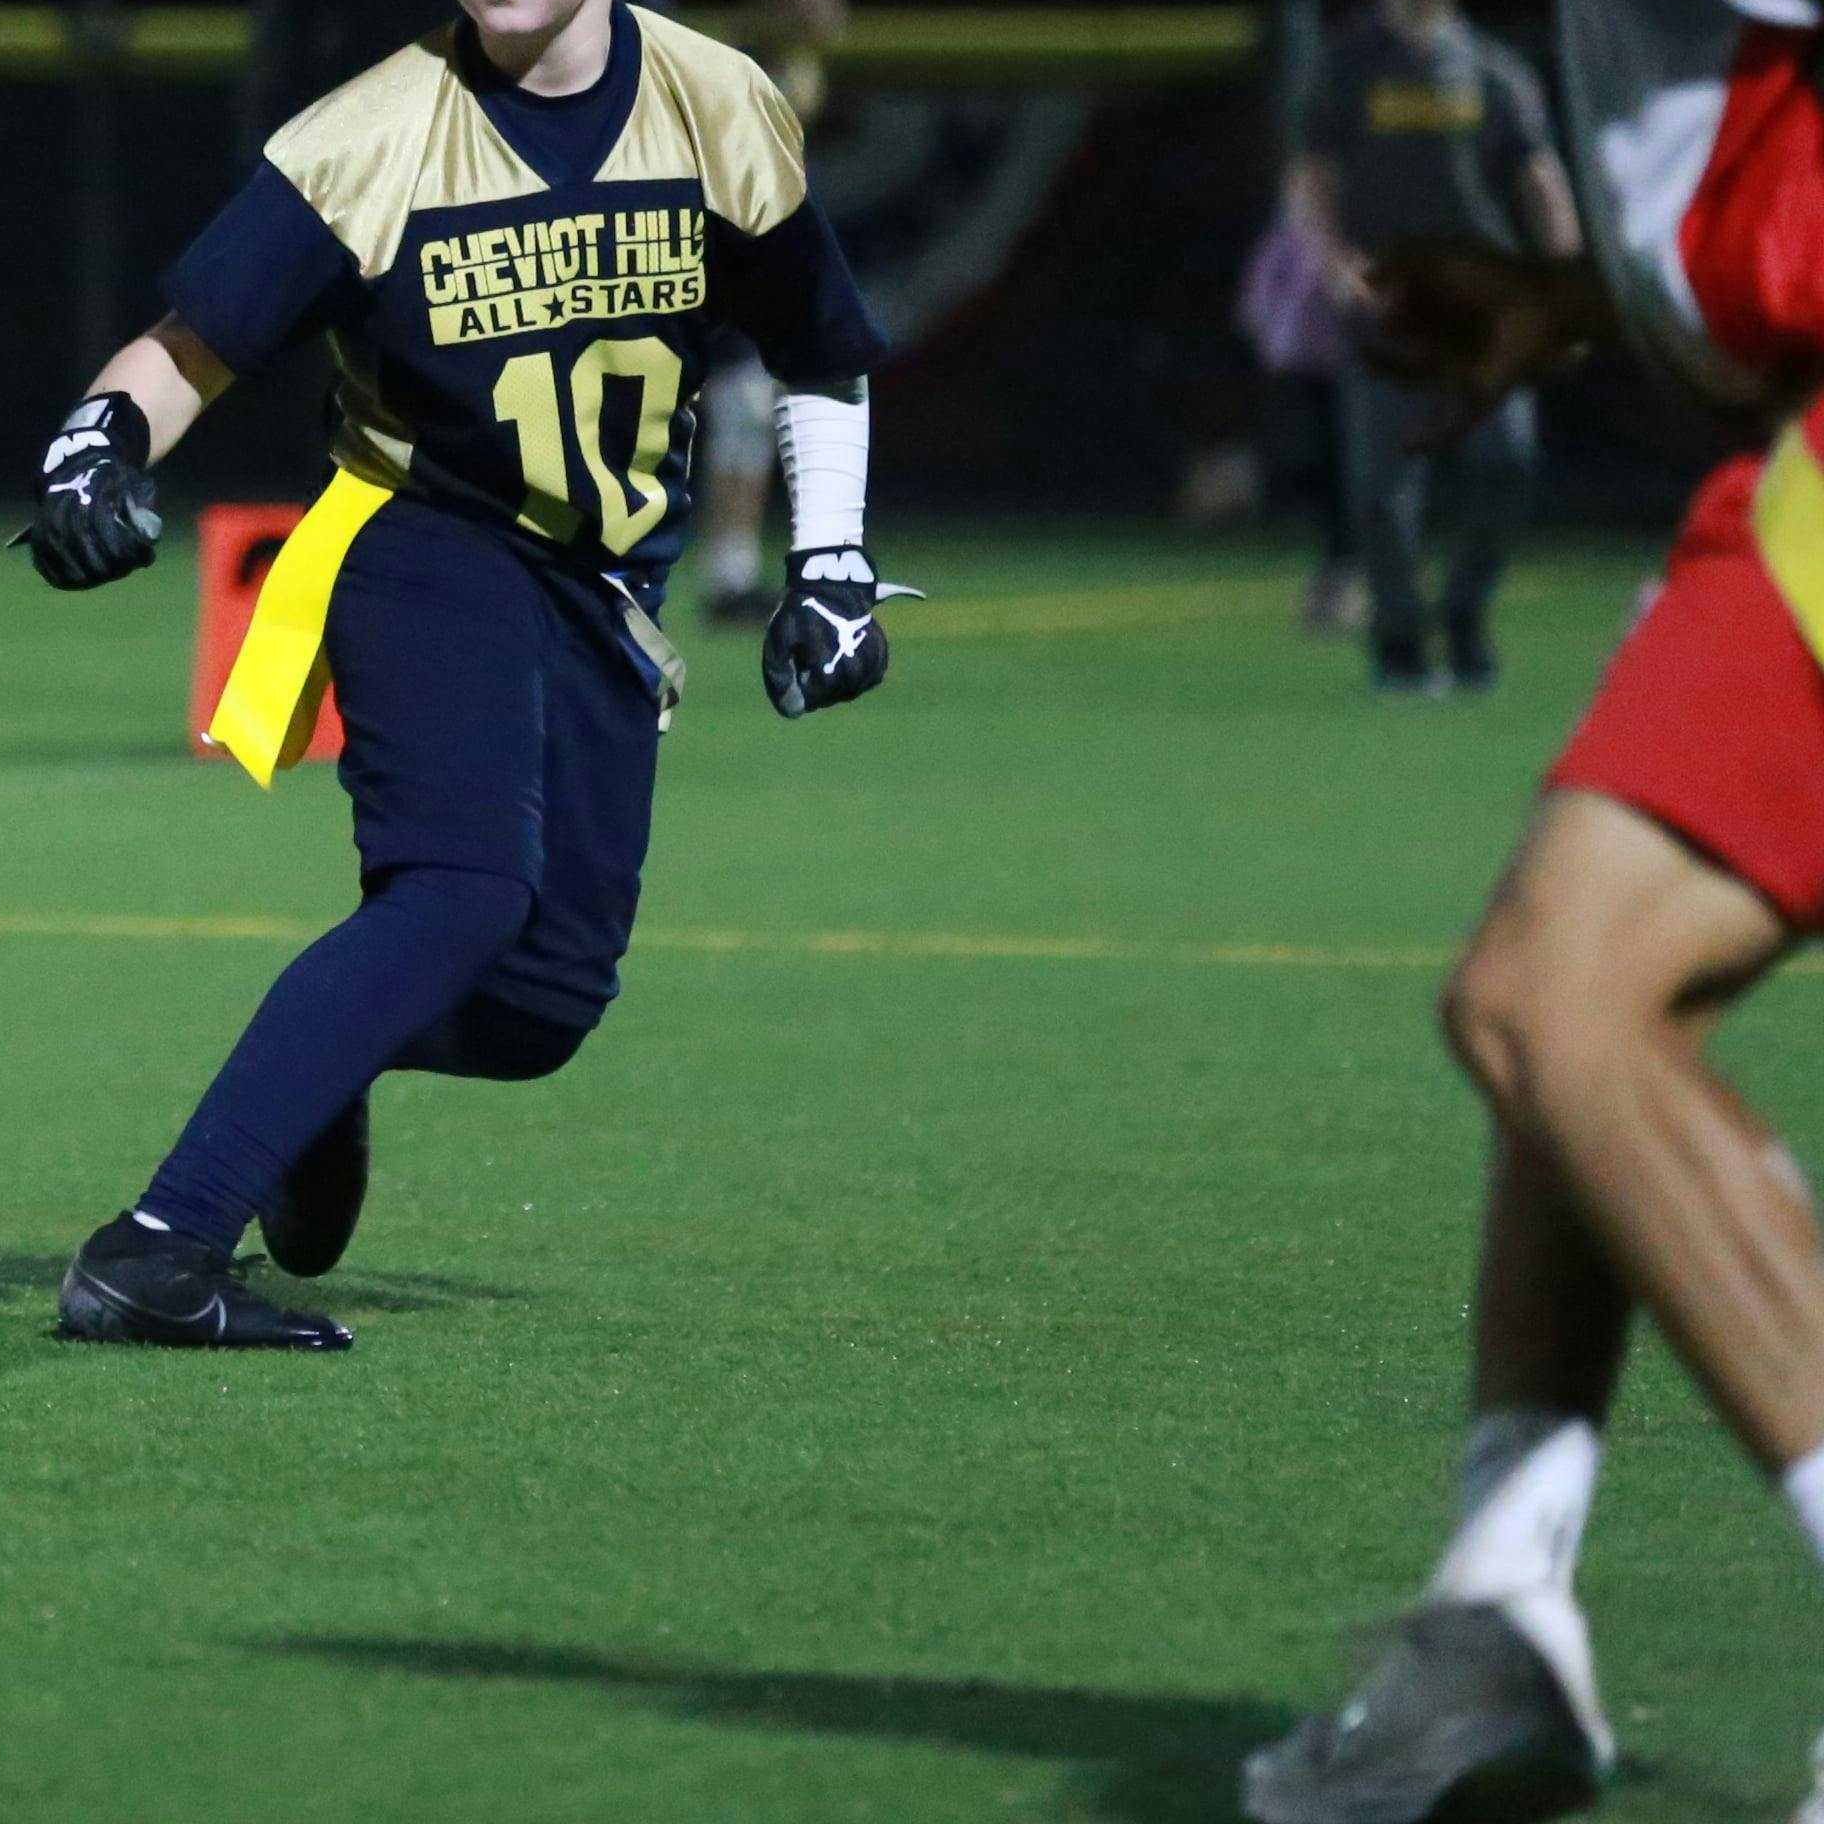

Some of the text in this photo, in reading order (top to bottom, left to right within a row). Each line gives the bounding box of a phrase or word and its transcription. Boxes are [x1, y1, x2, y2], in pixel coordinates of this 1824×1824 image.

[420, 213, 605, 306] CHEVIOT
[458, 275, 699, 338] ALL STARS
[492, 335, 683, 557] 10
